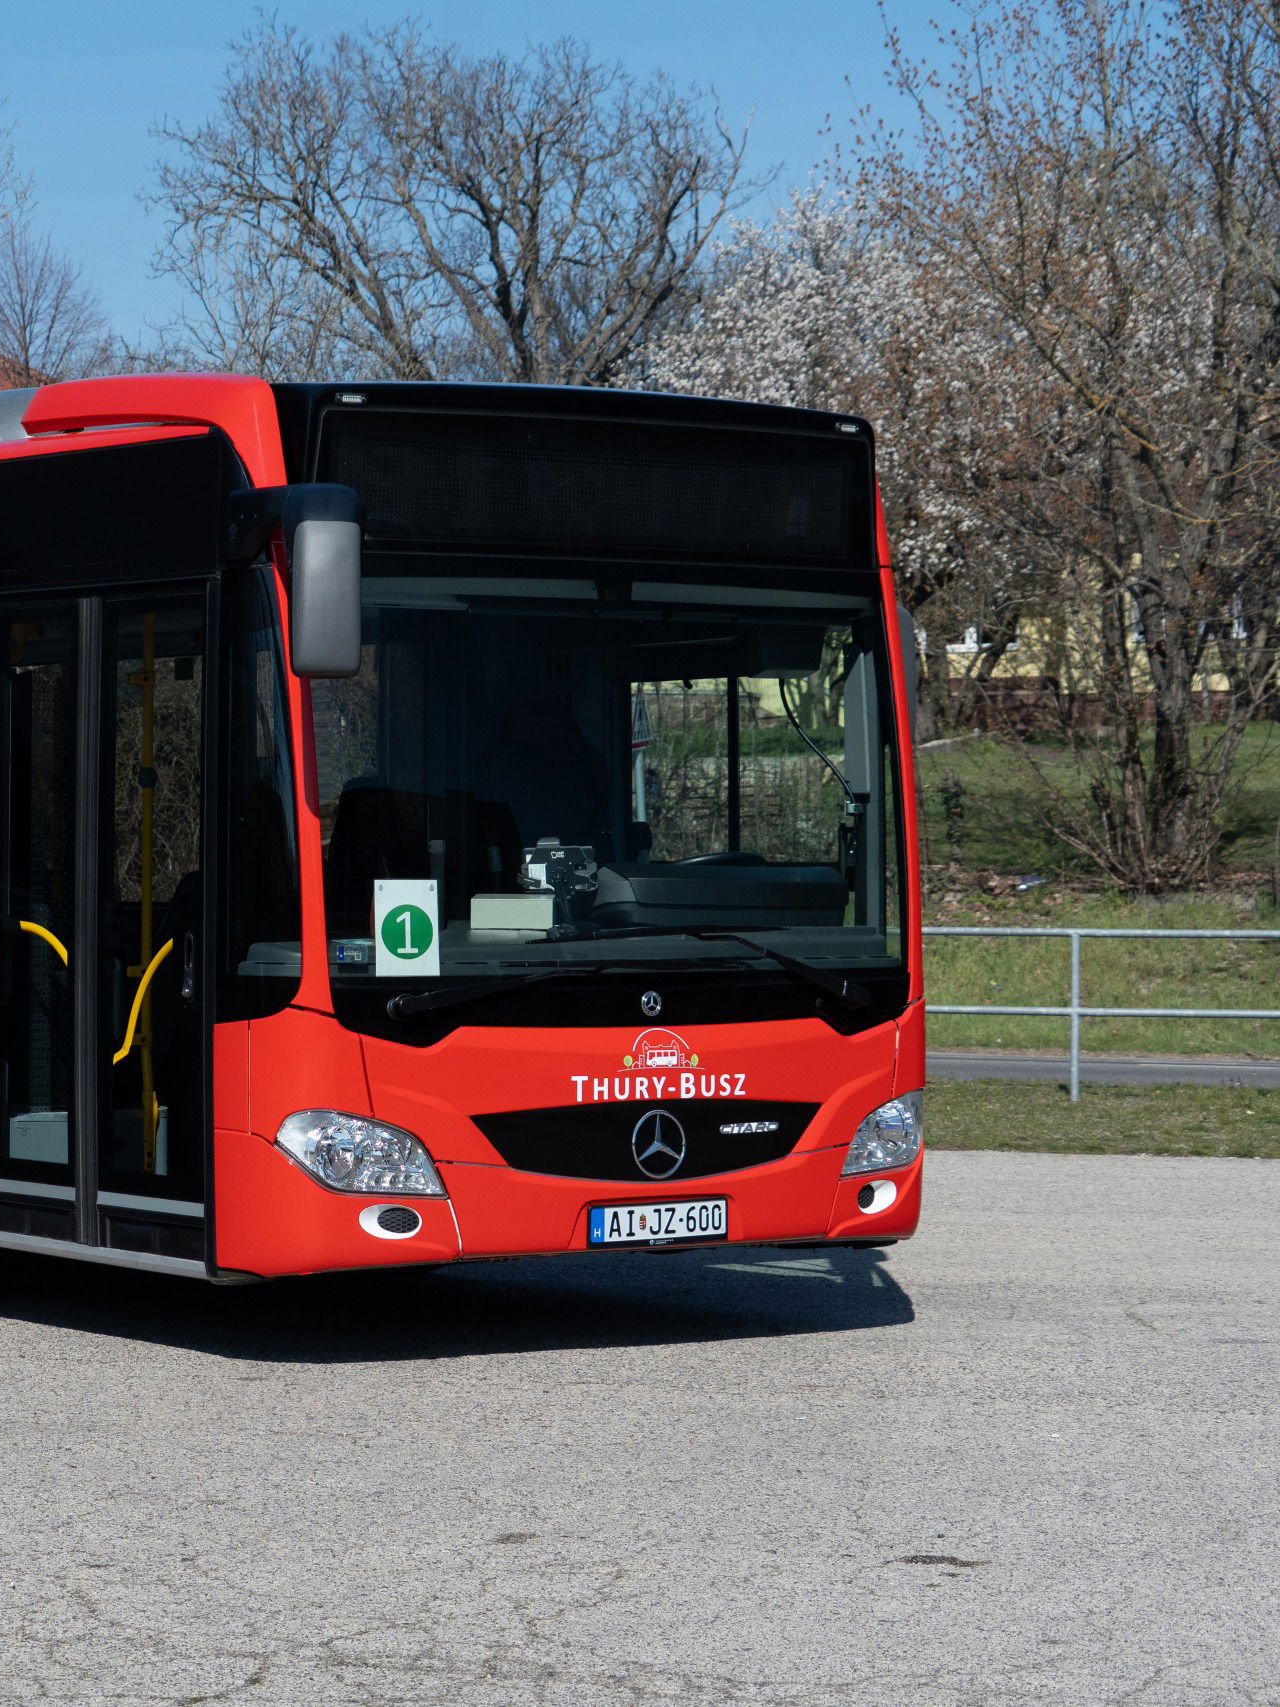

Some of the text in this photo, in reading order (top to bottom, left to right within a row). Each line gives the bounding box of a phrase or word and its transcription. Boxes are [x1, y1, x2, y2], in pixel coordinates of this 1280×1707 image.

[396, 911, 418, 953] 1
[571, 1072, 747, 1102] THURY-BUSZ
[719, 1121, 779, 1134] CITARO
[593, 1228, 601, 1238] H
[609, 1209, 636, 1238] AI
